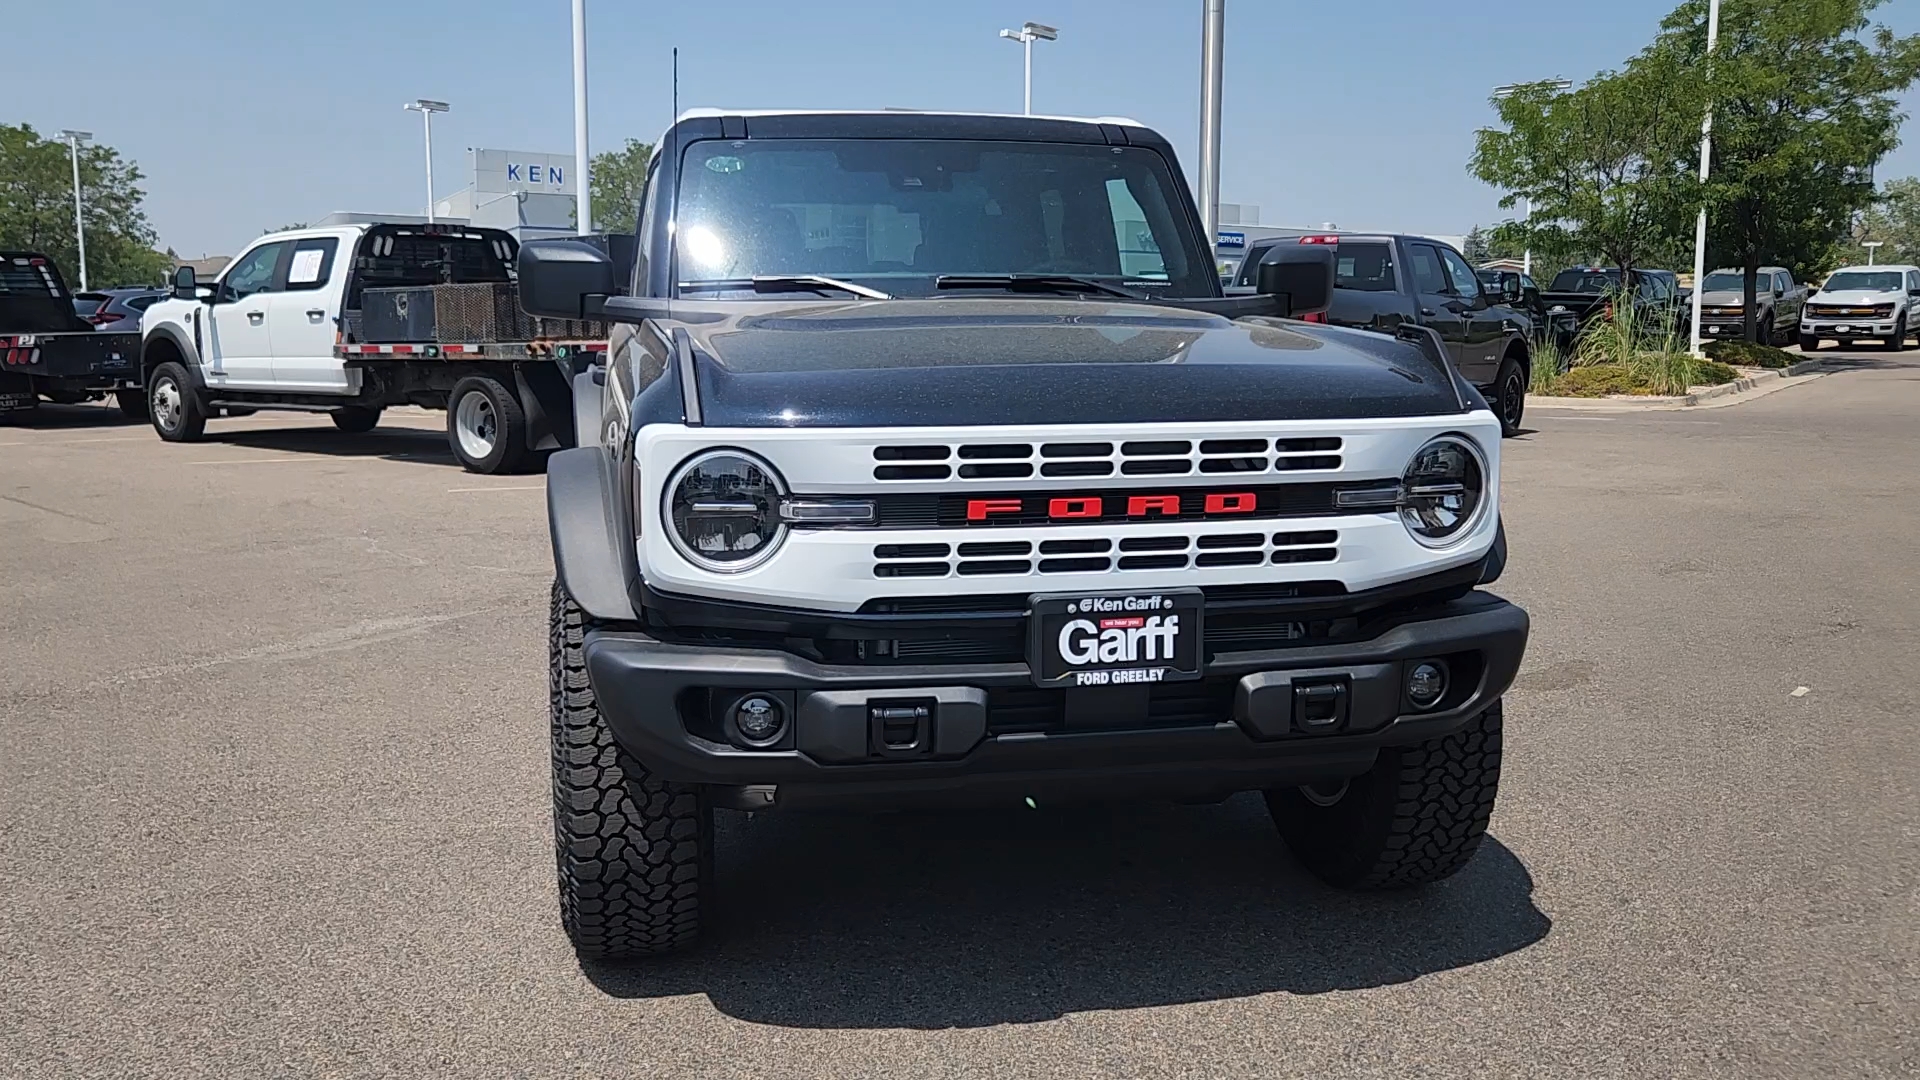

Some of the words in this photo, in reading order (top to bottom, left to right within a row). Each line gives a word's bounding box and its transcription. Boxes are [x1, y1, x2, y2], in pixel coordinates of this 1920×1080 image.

[507, 163, 564, 185] KEN
[1217, 235, 1243, 244] SERVICE
[967, 493, 1256, 520] FORD
[1093, 597, 1122, 612] Ken
[1124, 596, 1161, 611] Garff
[1058, 614, 1179, 666] Garff
[1076, 672, 1109, 686] FORD
[1111, 668, 1165, 684] GREELEY
